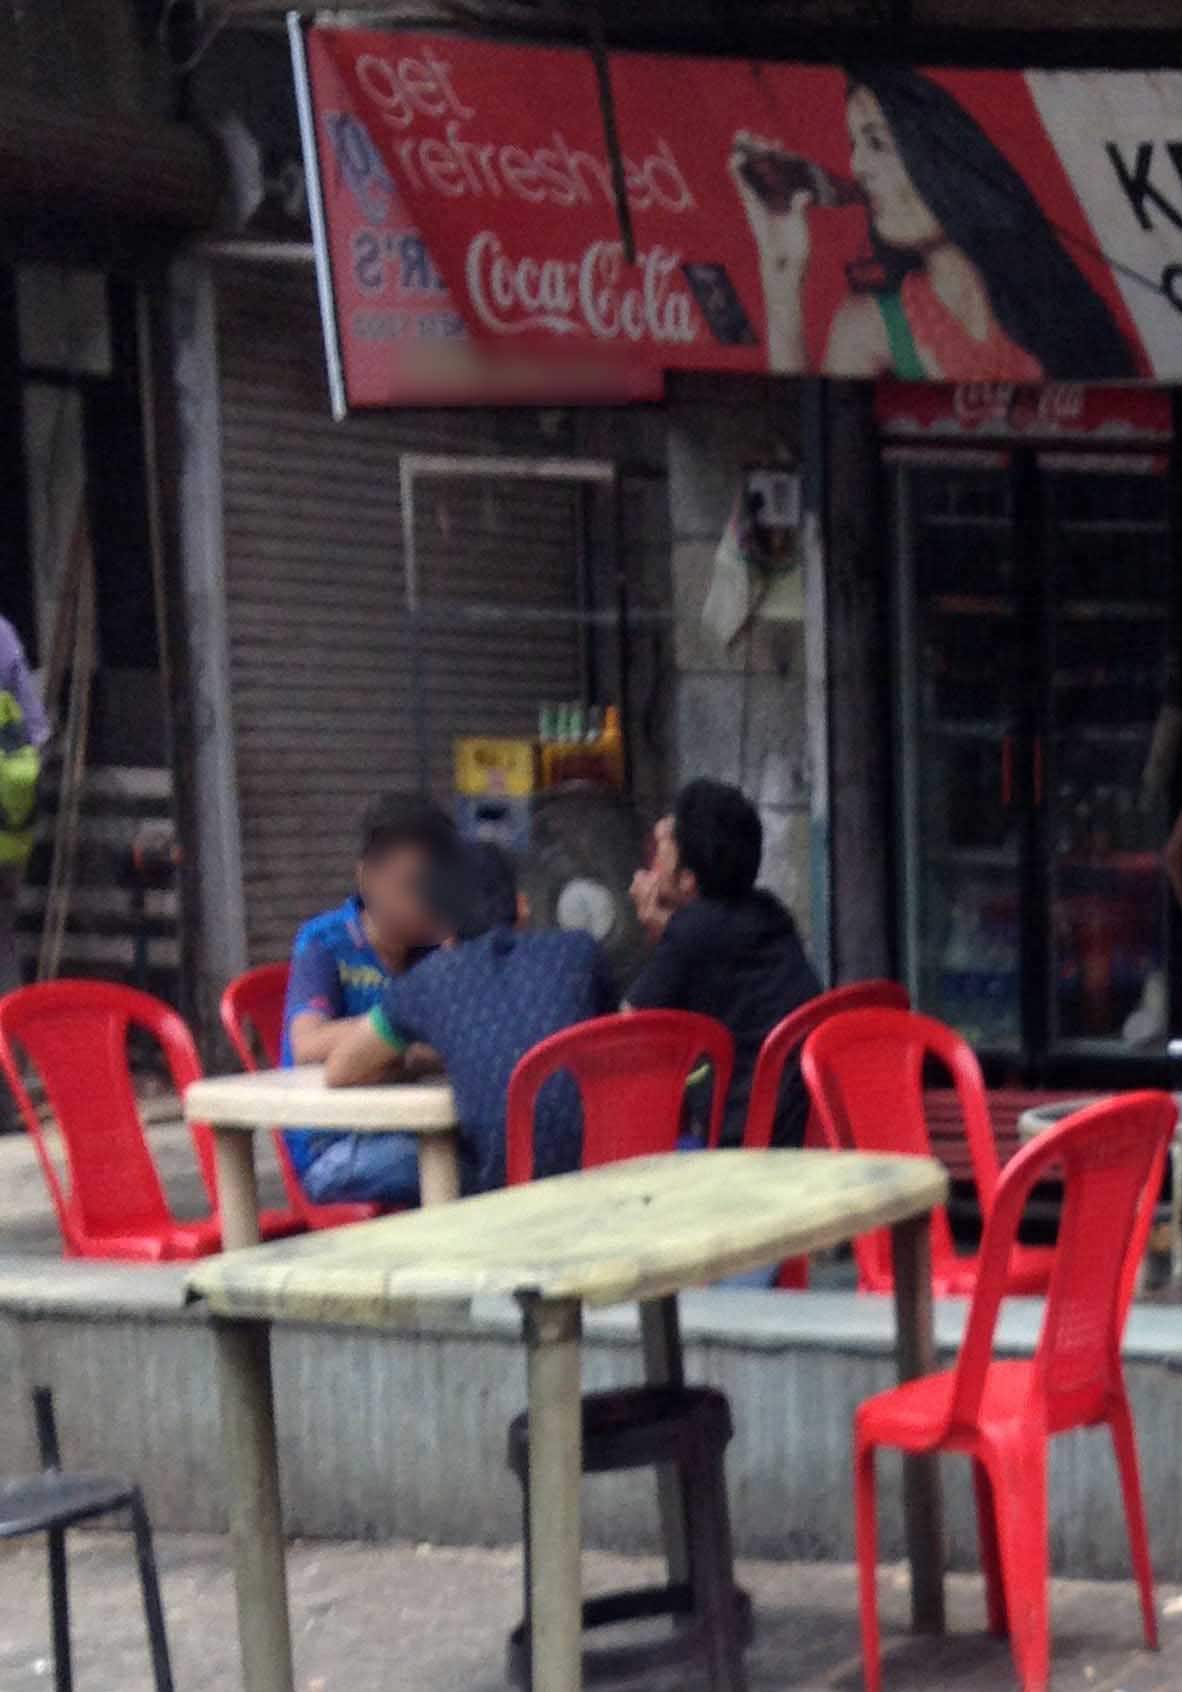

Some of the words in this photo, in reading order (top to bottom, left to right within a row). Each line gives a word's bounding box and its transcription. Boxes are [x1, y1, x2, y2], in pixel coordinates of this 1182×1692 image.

[354, 46, 475, 128] get
[394, 121, 697, 213] refreshed
[464, 230, 697, 344] Coca-Cola
